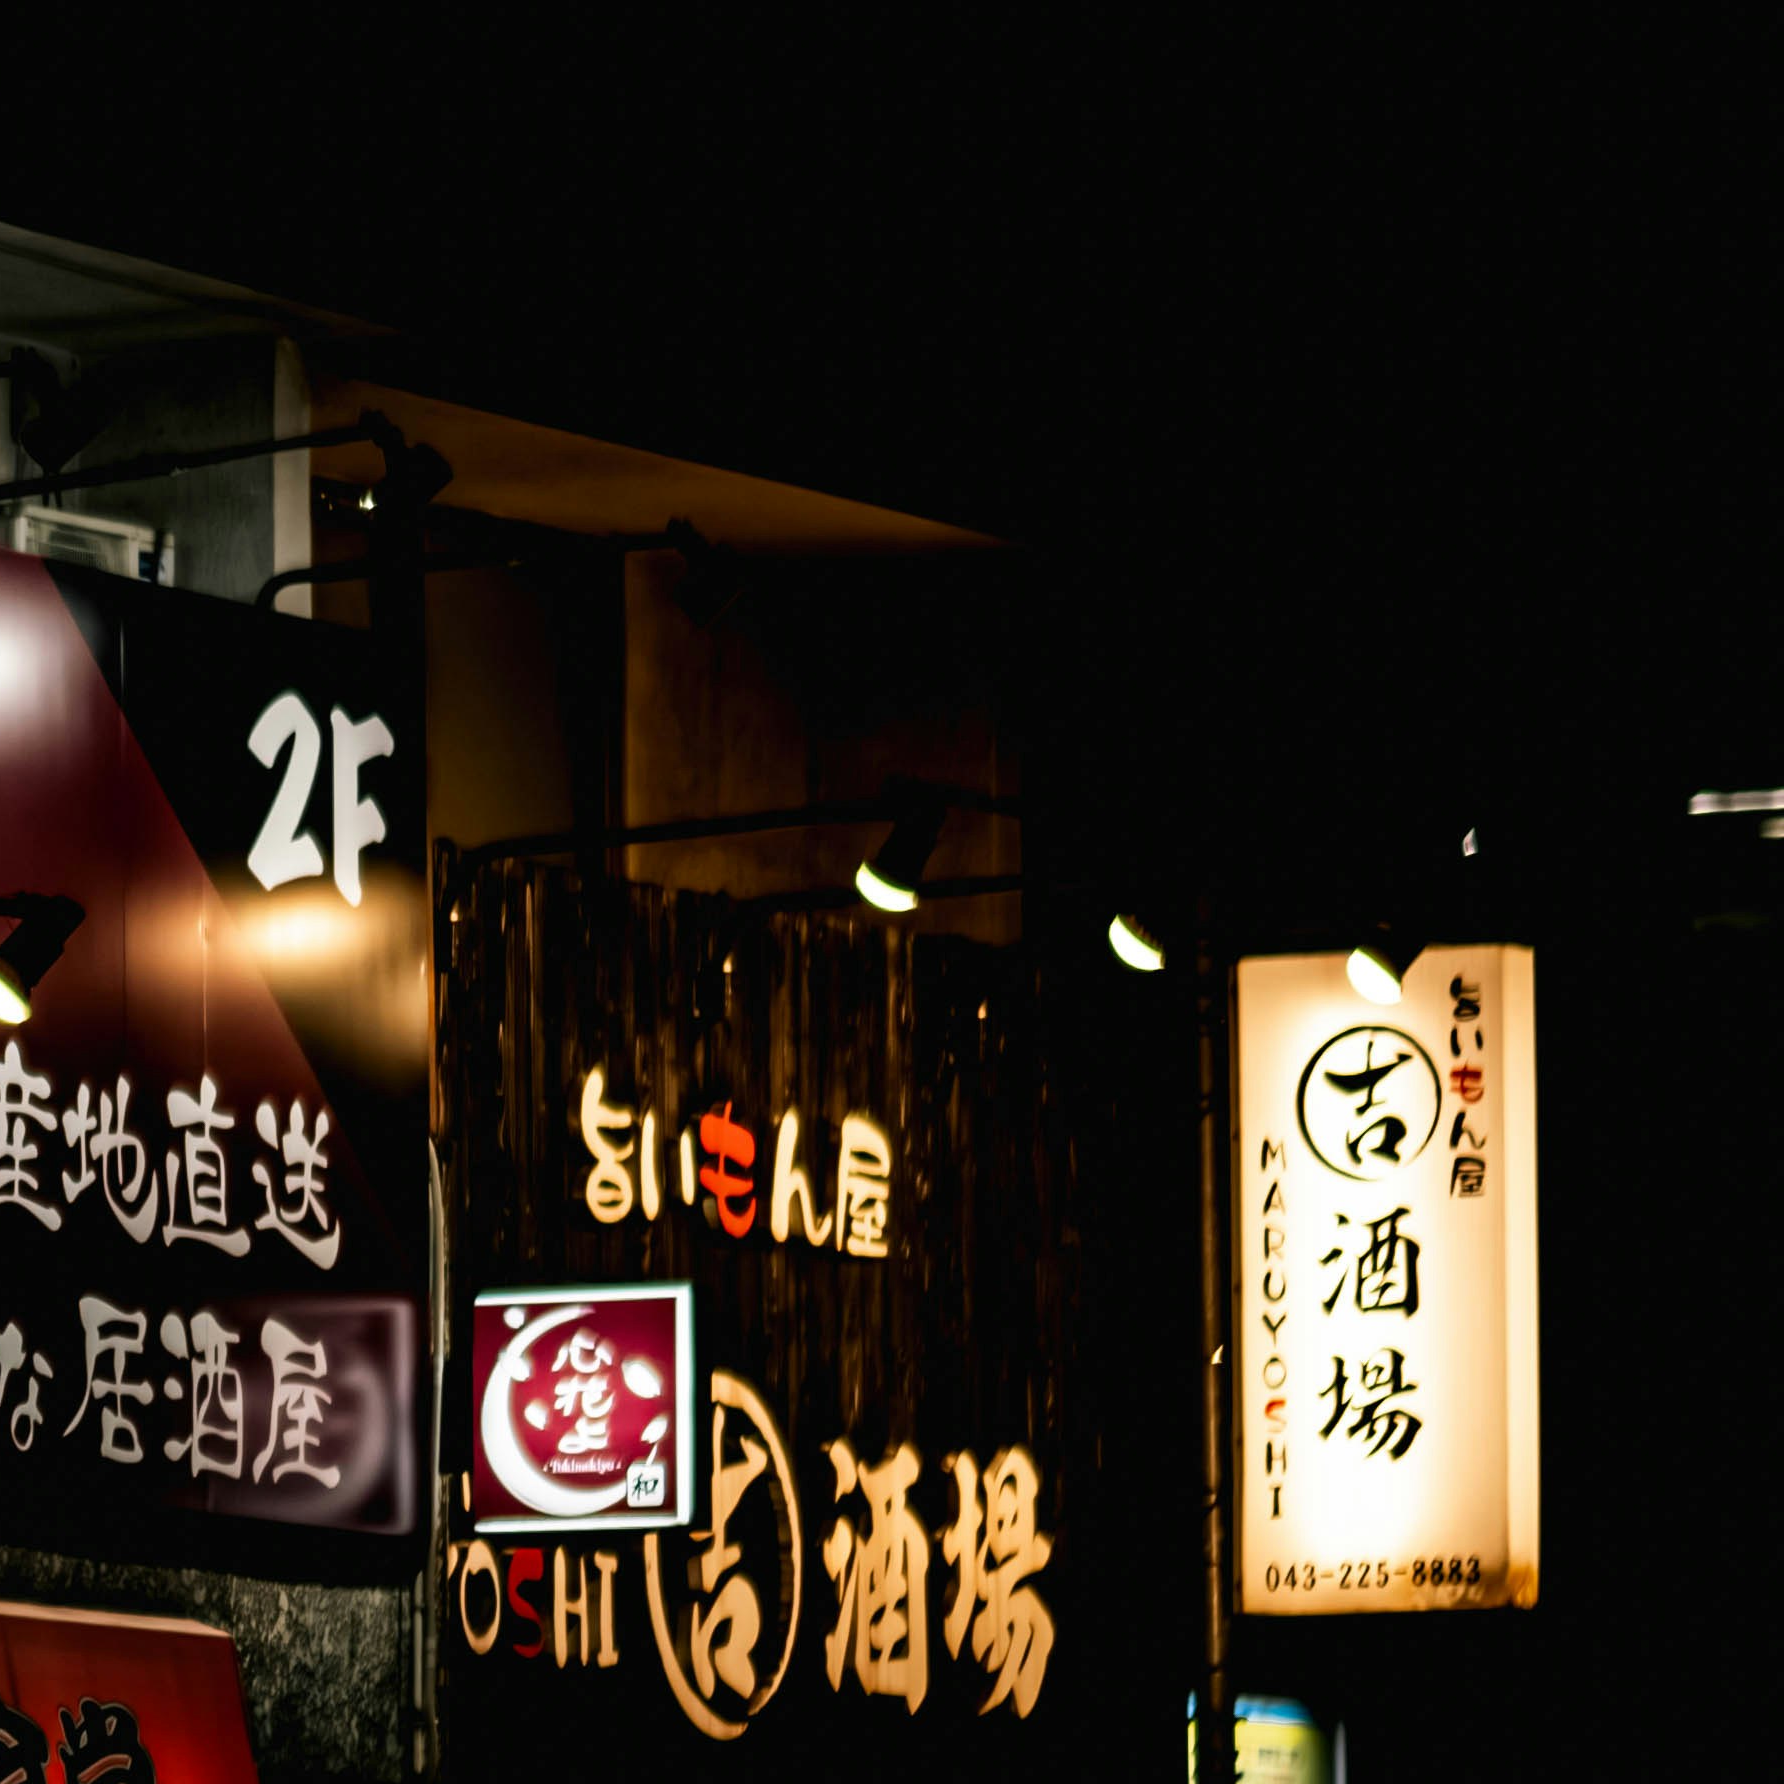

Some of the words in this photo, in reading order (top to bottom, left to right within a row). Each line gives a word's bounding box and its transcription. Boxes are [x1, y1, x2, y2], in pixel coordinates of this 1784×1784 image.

[245, 690, 395, 907] 2F
[579, 1066, 893, 1259] 旨いもん屋
[1259, 1136, 1290, 1521] MARUYOSHI
[1265, 1553, 1483, 1593] 043-225-8883
